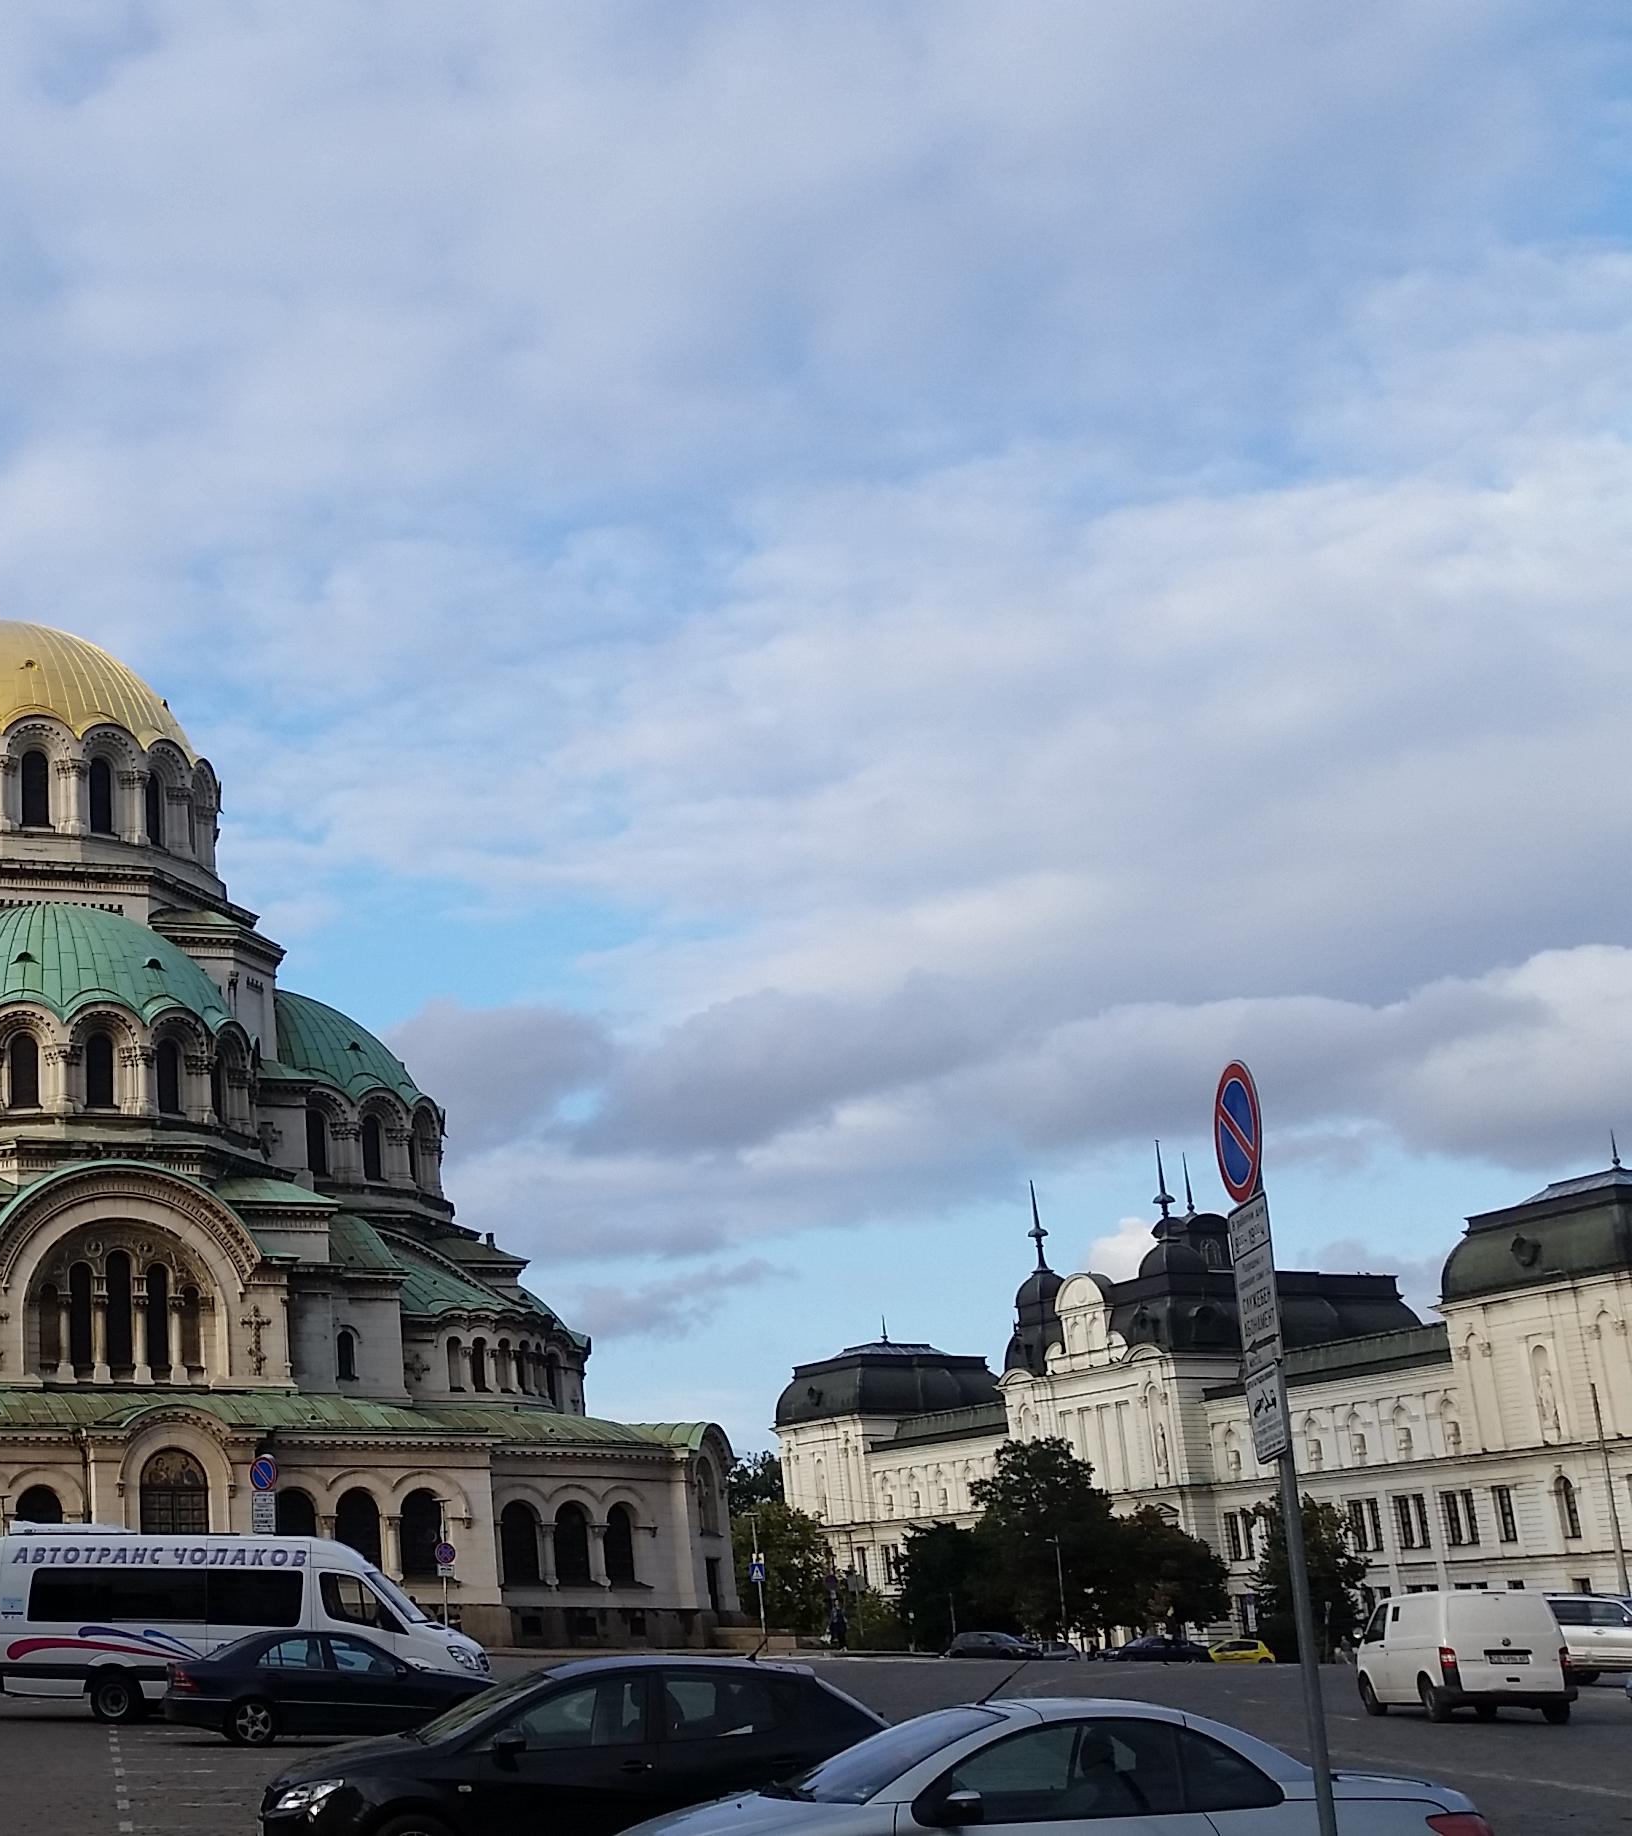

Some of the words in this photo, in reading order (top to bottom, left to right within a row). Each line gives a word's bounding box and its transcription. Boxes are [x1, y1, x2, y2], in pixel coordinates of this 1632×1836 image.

[1243, 1286, 1271, 1315] СЛУЖЕБЕН
[1245, 1307, 1275, 1337] АБОНАМЕНТ
[12, 1546, 164, 1565] АВТОТРАНС
[173, 1547, 308, 1567] ЧОЛАКОВ
